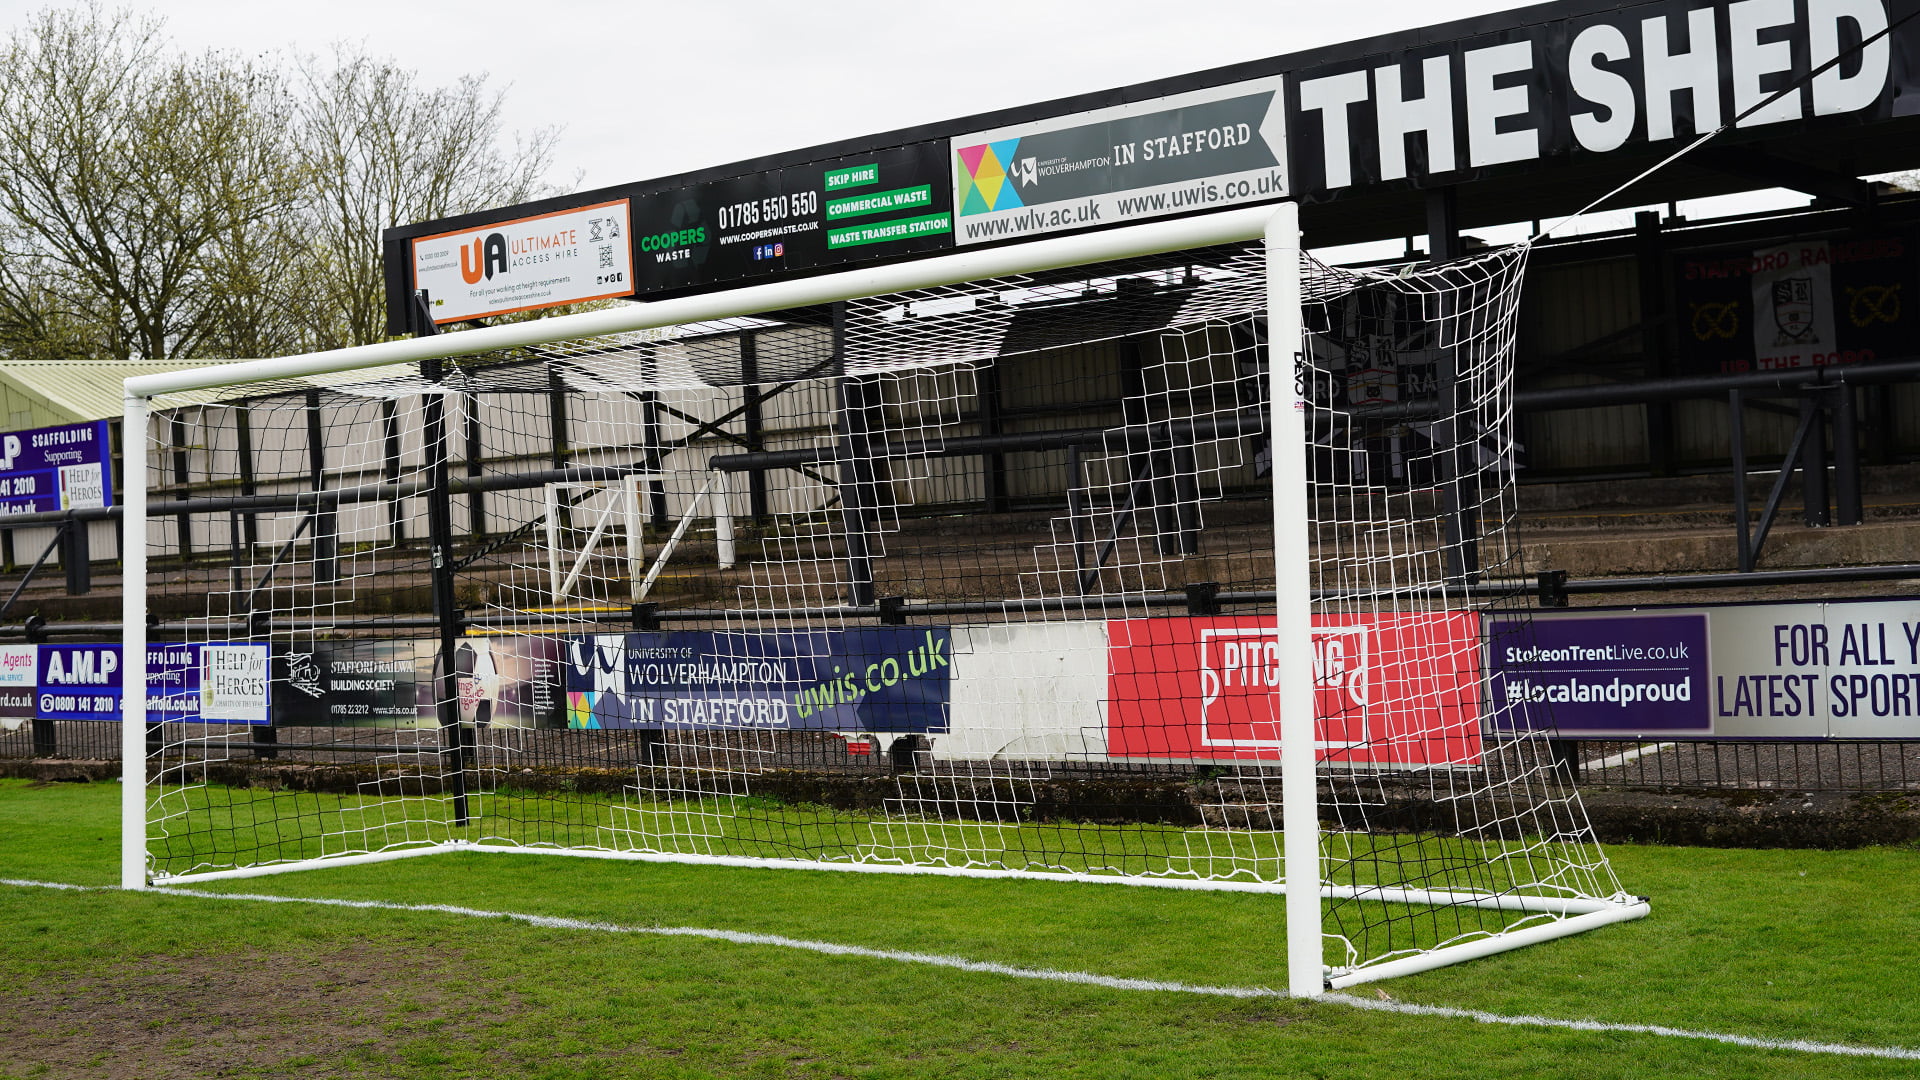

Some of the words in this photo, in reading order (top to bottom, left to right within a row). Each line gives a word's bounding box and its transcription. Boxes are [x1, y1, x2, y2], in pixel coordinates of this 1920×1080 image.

[1300, 40, 1540, 190] THE
[1568, 0, 1891, 153] SHED
[1113, 143, 1136, 167] IN
[1143, 123, 1251, 161] STAFFORD
[828, 173, 850, 187] SKIP
[851, 169, 875, 183] HIRE
[1038, 156, 1110, 177] WOLVERHAMPTON
[829, 195, 893, 215] COMMERCIAL
[894, 190, 928, 205] WASTE
[1117, 170, 1283, 216] www.uwis.co.uk
[718, 201, 759, 230] 01785
[762, 195, 788, 222] 550
[791, 190, 818, 218] 550
[966, 199, 1101, 239] www.wlv.ac.uk
[511, 229, 578, 255] ULTIMATE
[641, 226, 706, 252] COOPERS
[719, 220, 819, 246] WWW.COOPERSWASTE.CO.UK
[830, 231, 861, 245] WASTE
[861, 223, 907, 240] TRANSFER
[909, 218, 949, 233] STATION
[512, 252, 550, 267] ACCESS
[555, 248, 579, 260] HIRE
[655, 248, 691, 264] WASTE
[485, 288, 496, 297] your
[496, 284, 516, 294] working
[521, 280, 538, 291] height
[32, 427, 93, 448] SCAFFOLDING
[44, 447, 83, 466] Supporting
[13, 475, 36, 496] 2010
[69, 468, 90, 484] HELP
[70, 486, 102, 501] HEROES
[628, 647, 679, 660] UNIVERSITY
[680, 647, 693, 660] OF
[1506, 641, 1689, 663] StokeonTrentLive.co.uk
[1774, 623, 1829, 667] FOR
[1839, 622, 1896, 666] ALL
[3, 651, 32, 671] Agents
[46, 650, 118, 685] A.M.P
[216, 650, 247, 670] HELP
[330, 660, 377, 674] STAFFORD
[1224, 640, 1344, 687] PITCNG
[628, 661, 788, 685] WOLVERHAMPTON
[794, 629, 949, 719] uwis.co.uk
[216, 675, 264, 696] HEROES
[330, 679, 365, 691] BUILDING
[365, 679, 396, 691] SOCIETY
[1507, 675, 1691, 708] #localandproud
[1717, 674, 1819, 718] LATEST
[55, 695, 76, 712] 0800
[77, 696, 91, 712] 141
[93, 696, 114, 712] 2010
[629, 698, 656, 723] IN
[664, 698, 788, 724] STAFFORD
